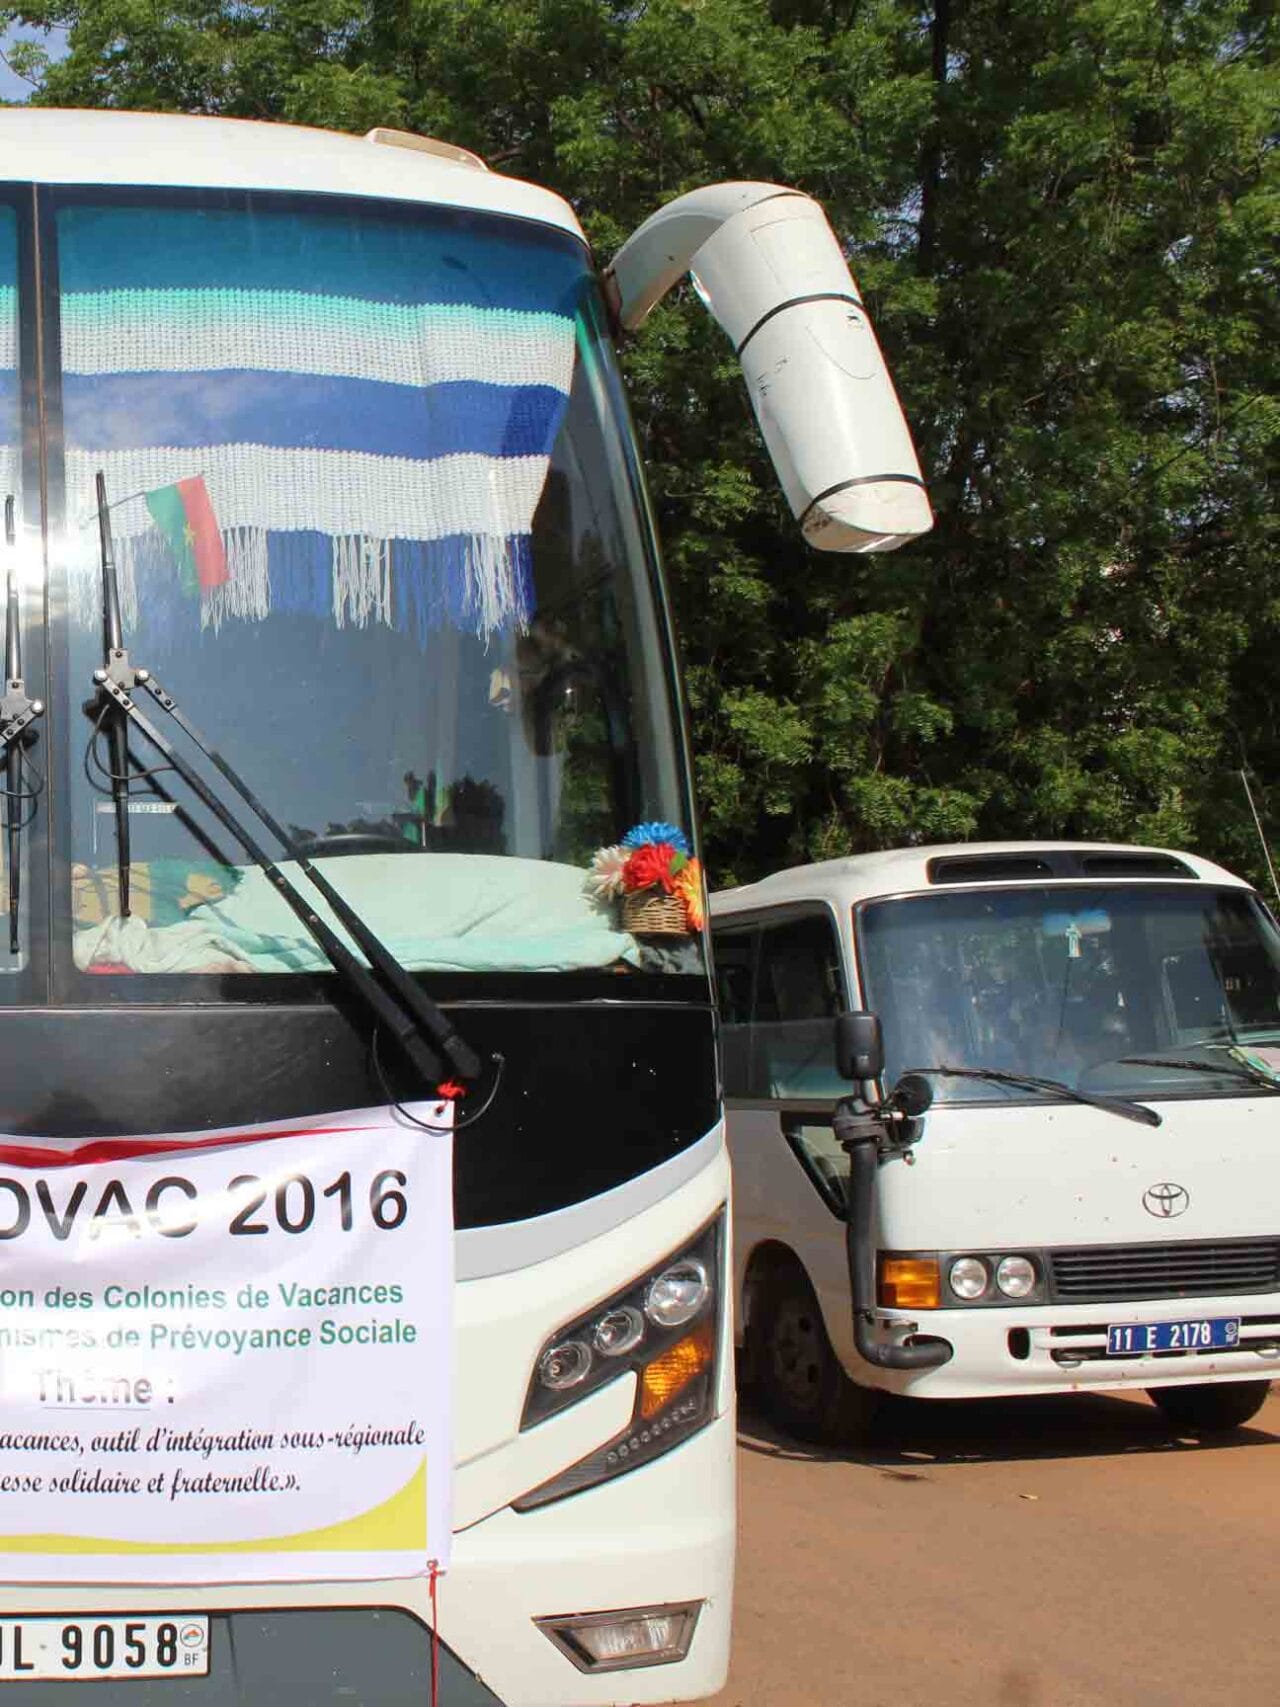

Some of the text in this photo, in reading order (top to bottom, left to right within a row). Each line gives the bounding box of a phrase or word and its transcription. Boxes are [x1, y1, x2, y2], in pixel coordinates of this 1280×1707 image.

[227, 1169, 408, 1236] 2016
[44, 1286, 93, 1309] des
[104, 1284, 227, 1309] Colonies
[237, 1284, 269, 1308] de
[278, 1282, 403, 1307] Vacances
[107, 1323, 140, 1349] de
[151, 1323, 311, 1355] Prévoyance
[320, 1318, 416, 1345] Sociale
[1114, 1321, 1211, 1350] 11 E 2178
[33, 1367, 152, 1404] Thme
[90, 1428, 141, 1452] outil
[279, 1420, 425, 1454] sous-régionale
[49, 1468, 141, 1494] solidaire
[147, 1472, 164, 1493] et
[61, 1623, 178, 1670] 9058
[184, 1652, 199, 1666] BF
